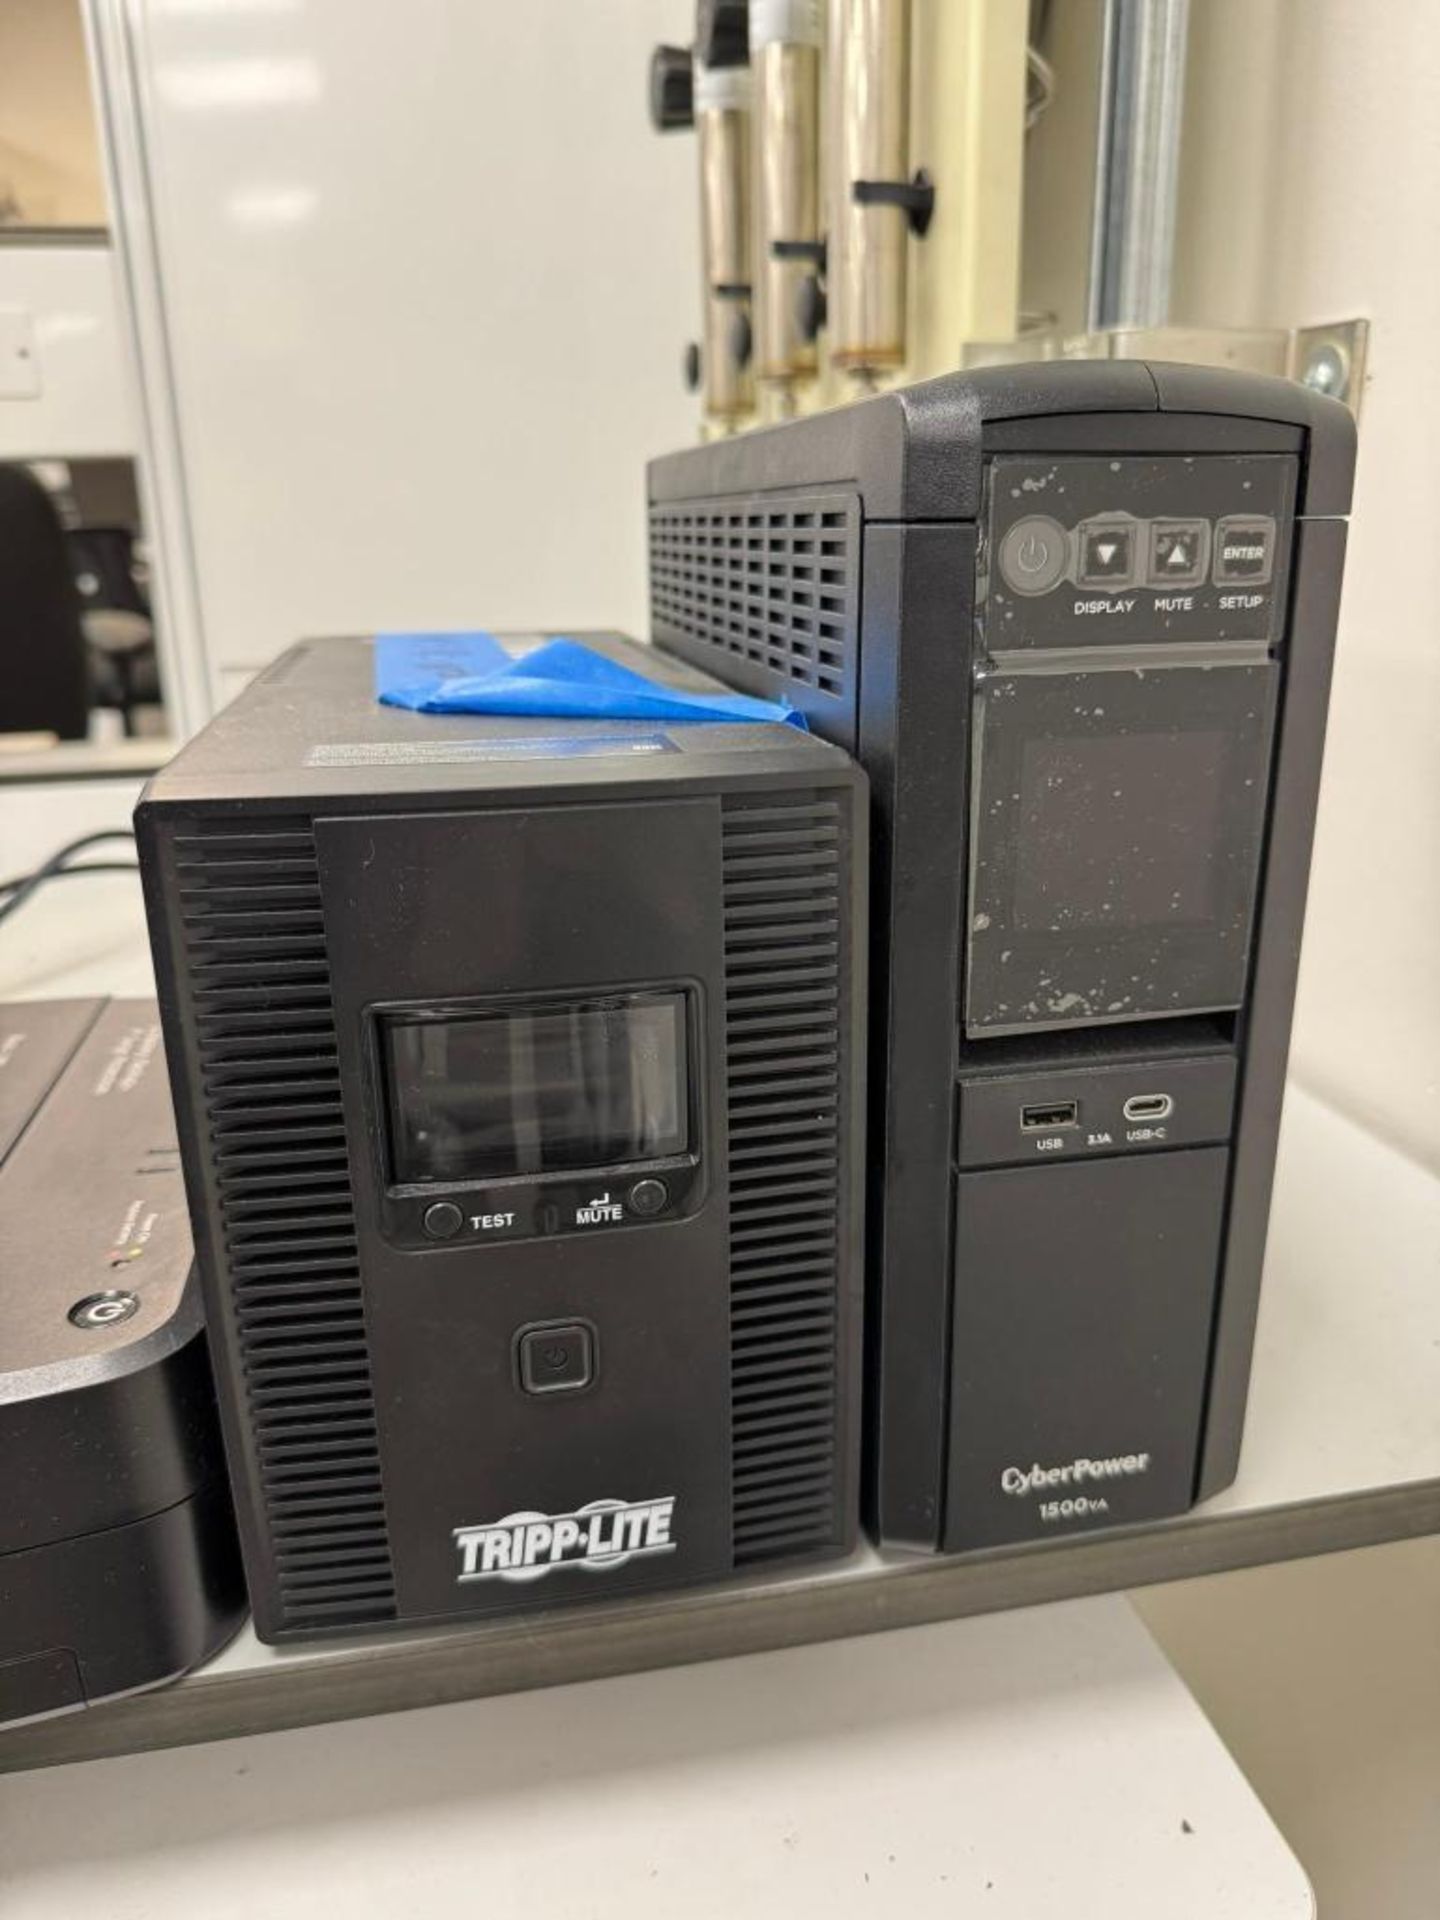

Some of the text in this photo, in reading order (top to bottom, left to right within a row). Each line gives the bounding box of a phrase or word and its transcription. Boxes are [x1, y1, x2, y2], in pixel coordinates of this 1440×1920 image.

[1224, 546, 1265, 559] ENTER
[1074, 595, 1263, 614] DISPLAY MUTE SETUP
[1036, 1138, 1064, 1150] USB
[1126, 1127, 1166, 1141] USB-C
[470, 1207, 623, 1230] TEST MUTE
[1001, 1453, 1149, 1494] CyberPower
